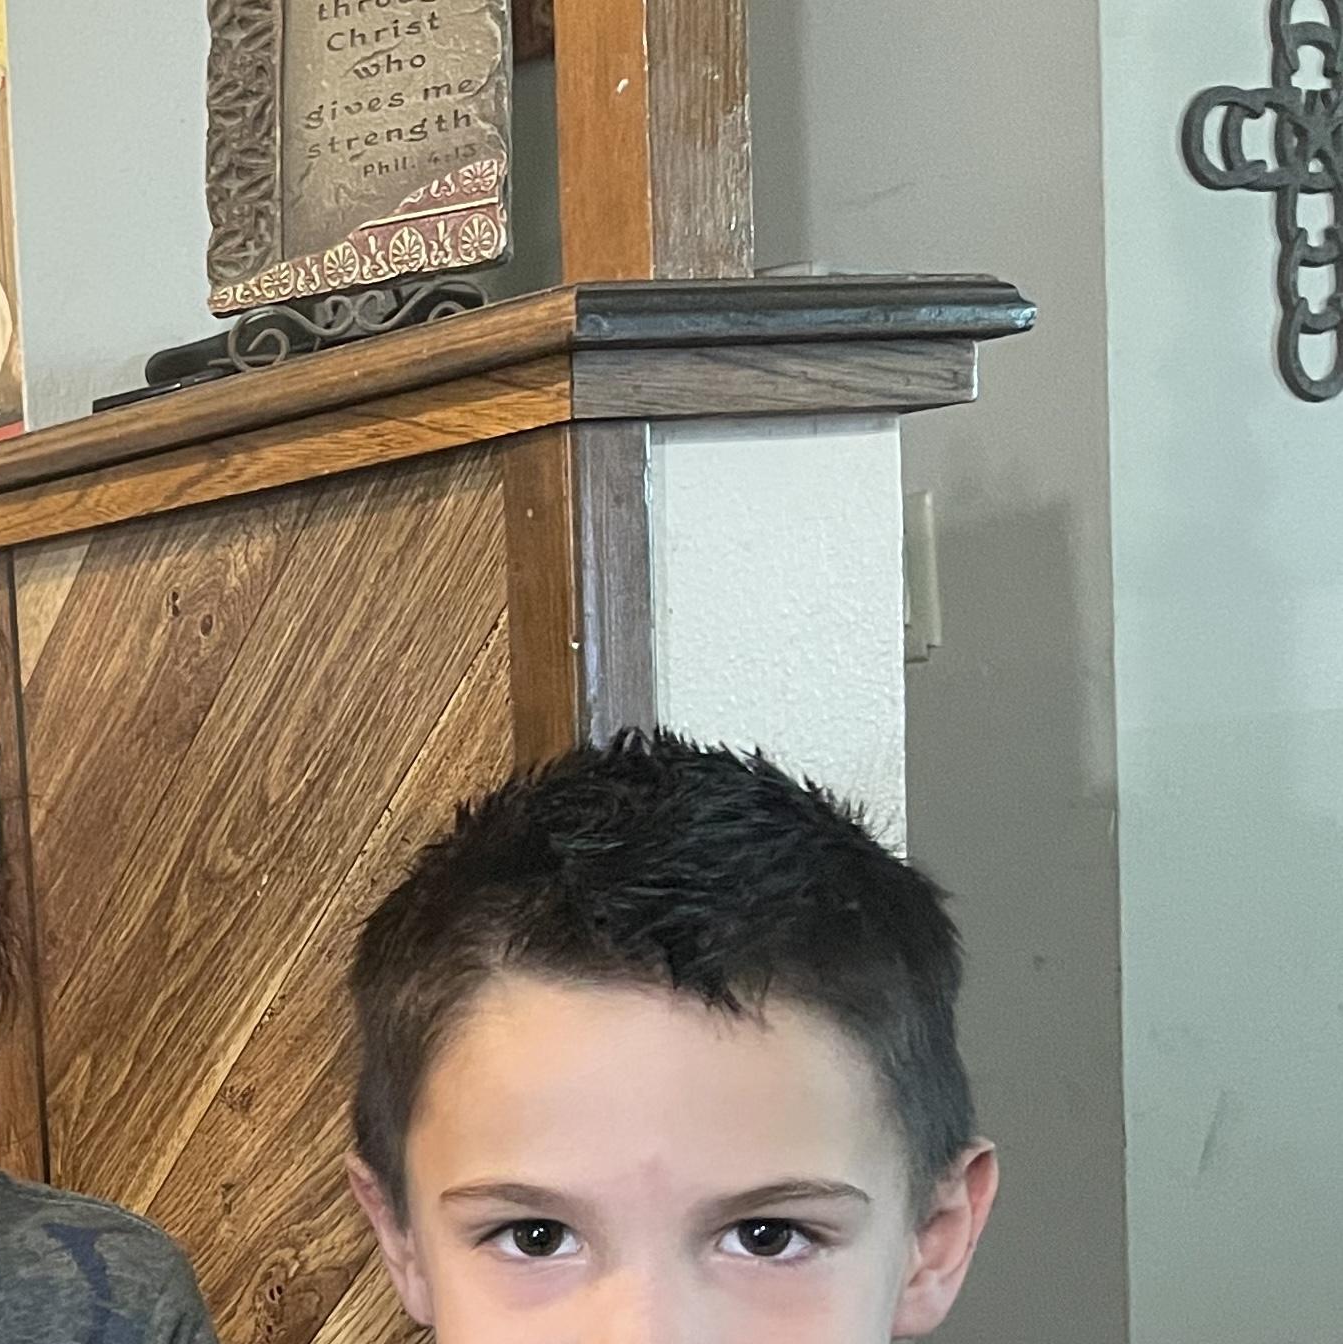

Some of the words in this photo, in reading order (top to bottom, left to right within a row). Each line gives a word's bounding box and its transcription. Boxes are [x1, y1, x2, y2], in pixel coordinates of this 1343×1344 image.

[327, 11, 439, 51] Christ
[354, 54, 426, 80] who
[305, 92, 405, 129] gives
[423, 79, 474, 101] me
[307, 109, 471, 159] strength
[363, 156, 416, 178] Phil.
